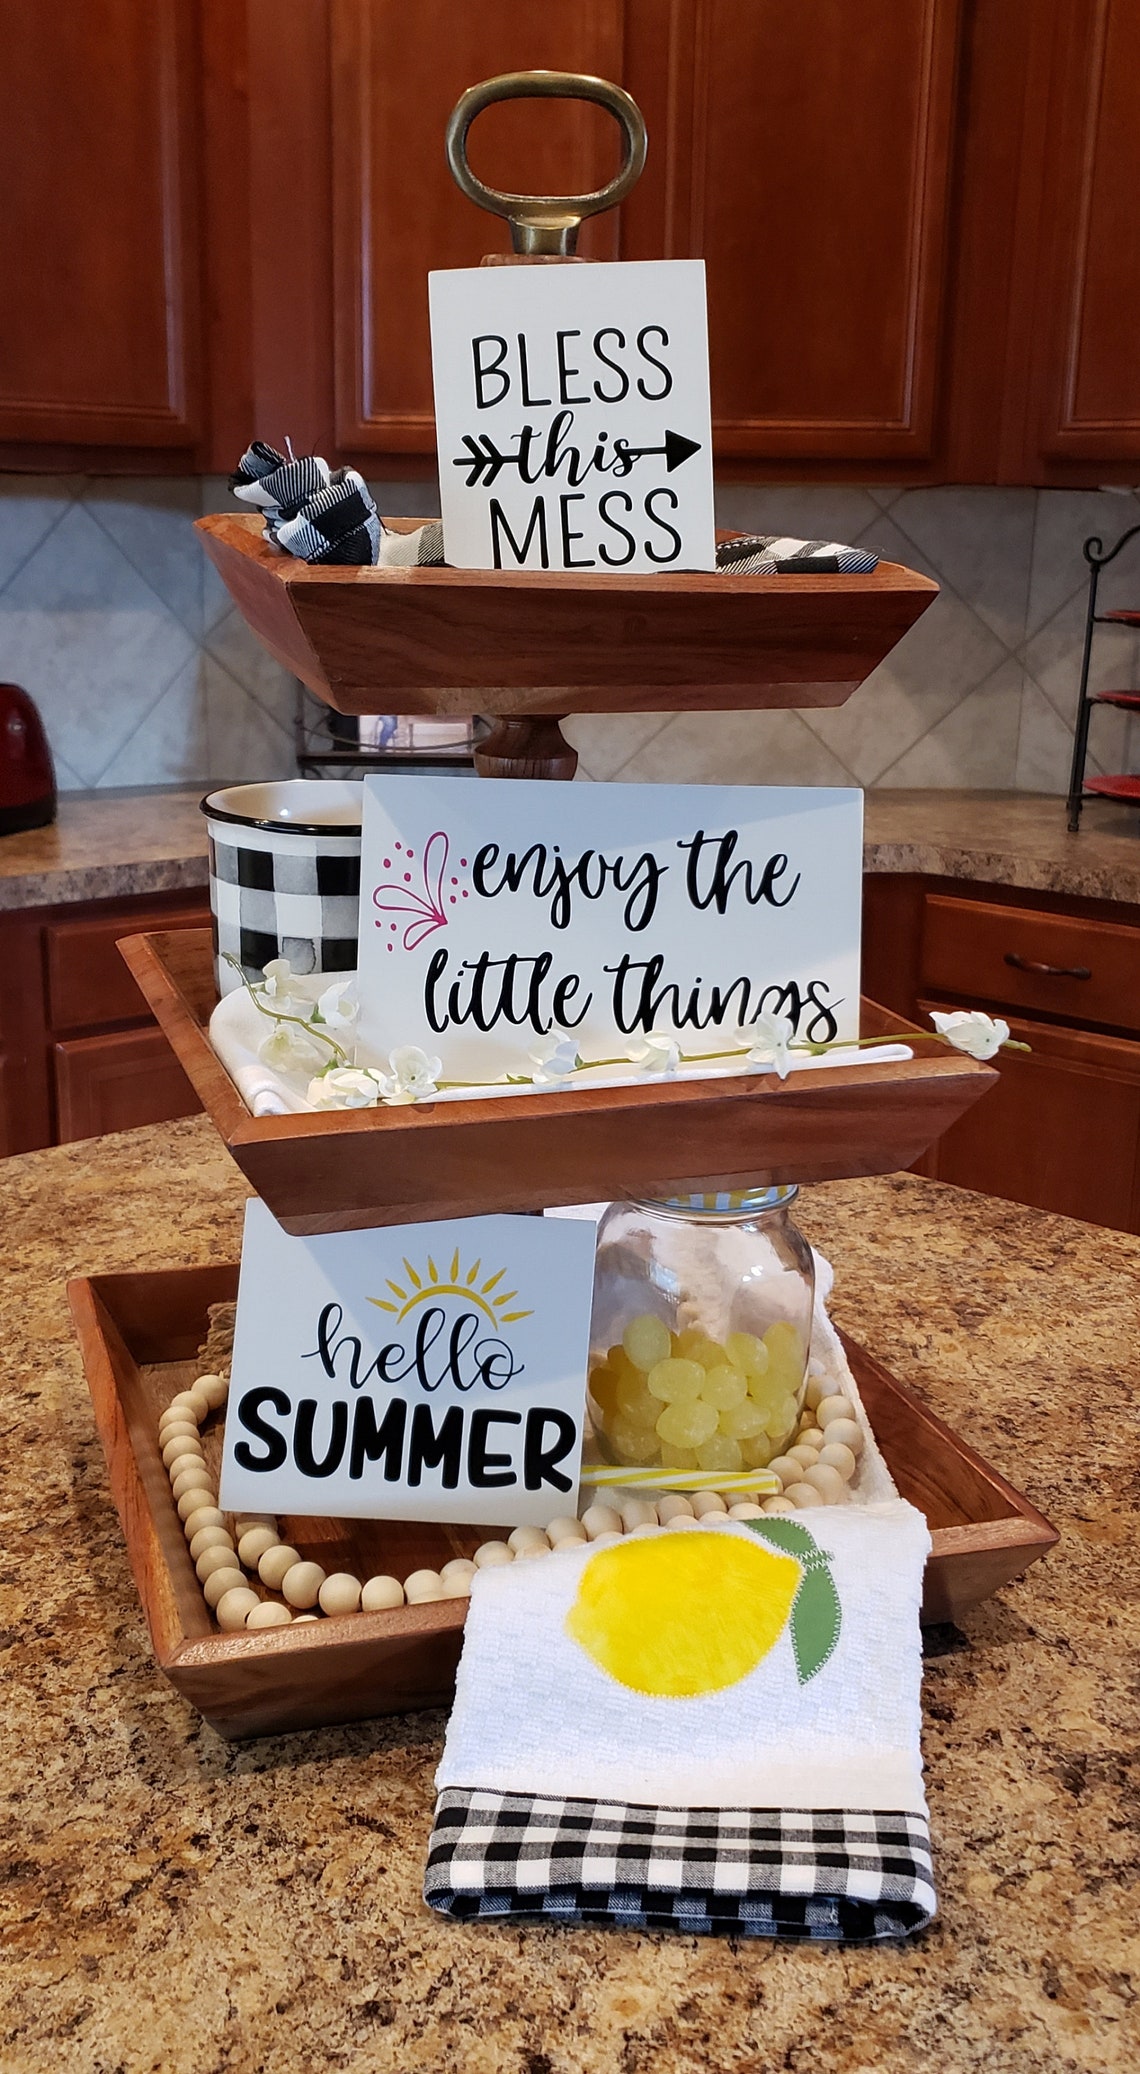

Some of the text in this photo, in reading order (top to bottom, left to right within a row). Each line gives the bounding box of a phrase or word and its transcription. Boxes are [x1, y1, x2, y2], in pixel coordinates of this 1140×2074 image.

[471, 325, 673, 410] BLESS
[510, 409, 642, 487] this
[489, 487, 682, 570] MESS
[472, 829, 801, 932] enjoy the
[424, 948, 592, 1035] little
[300, 1302, 525, 1392] hello
[234, 1386, 577, 1493] SUMMER
